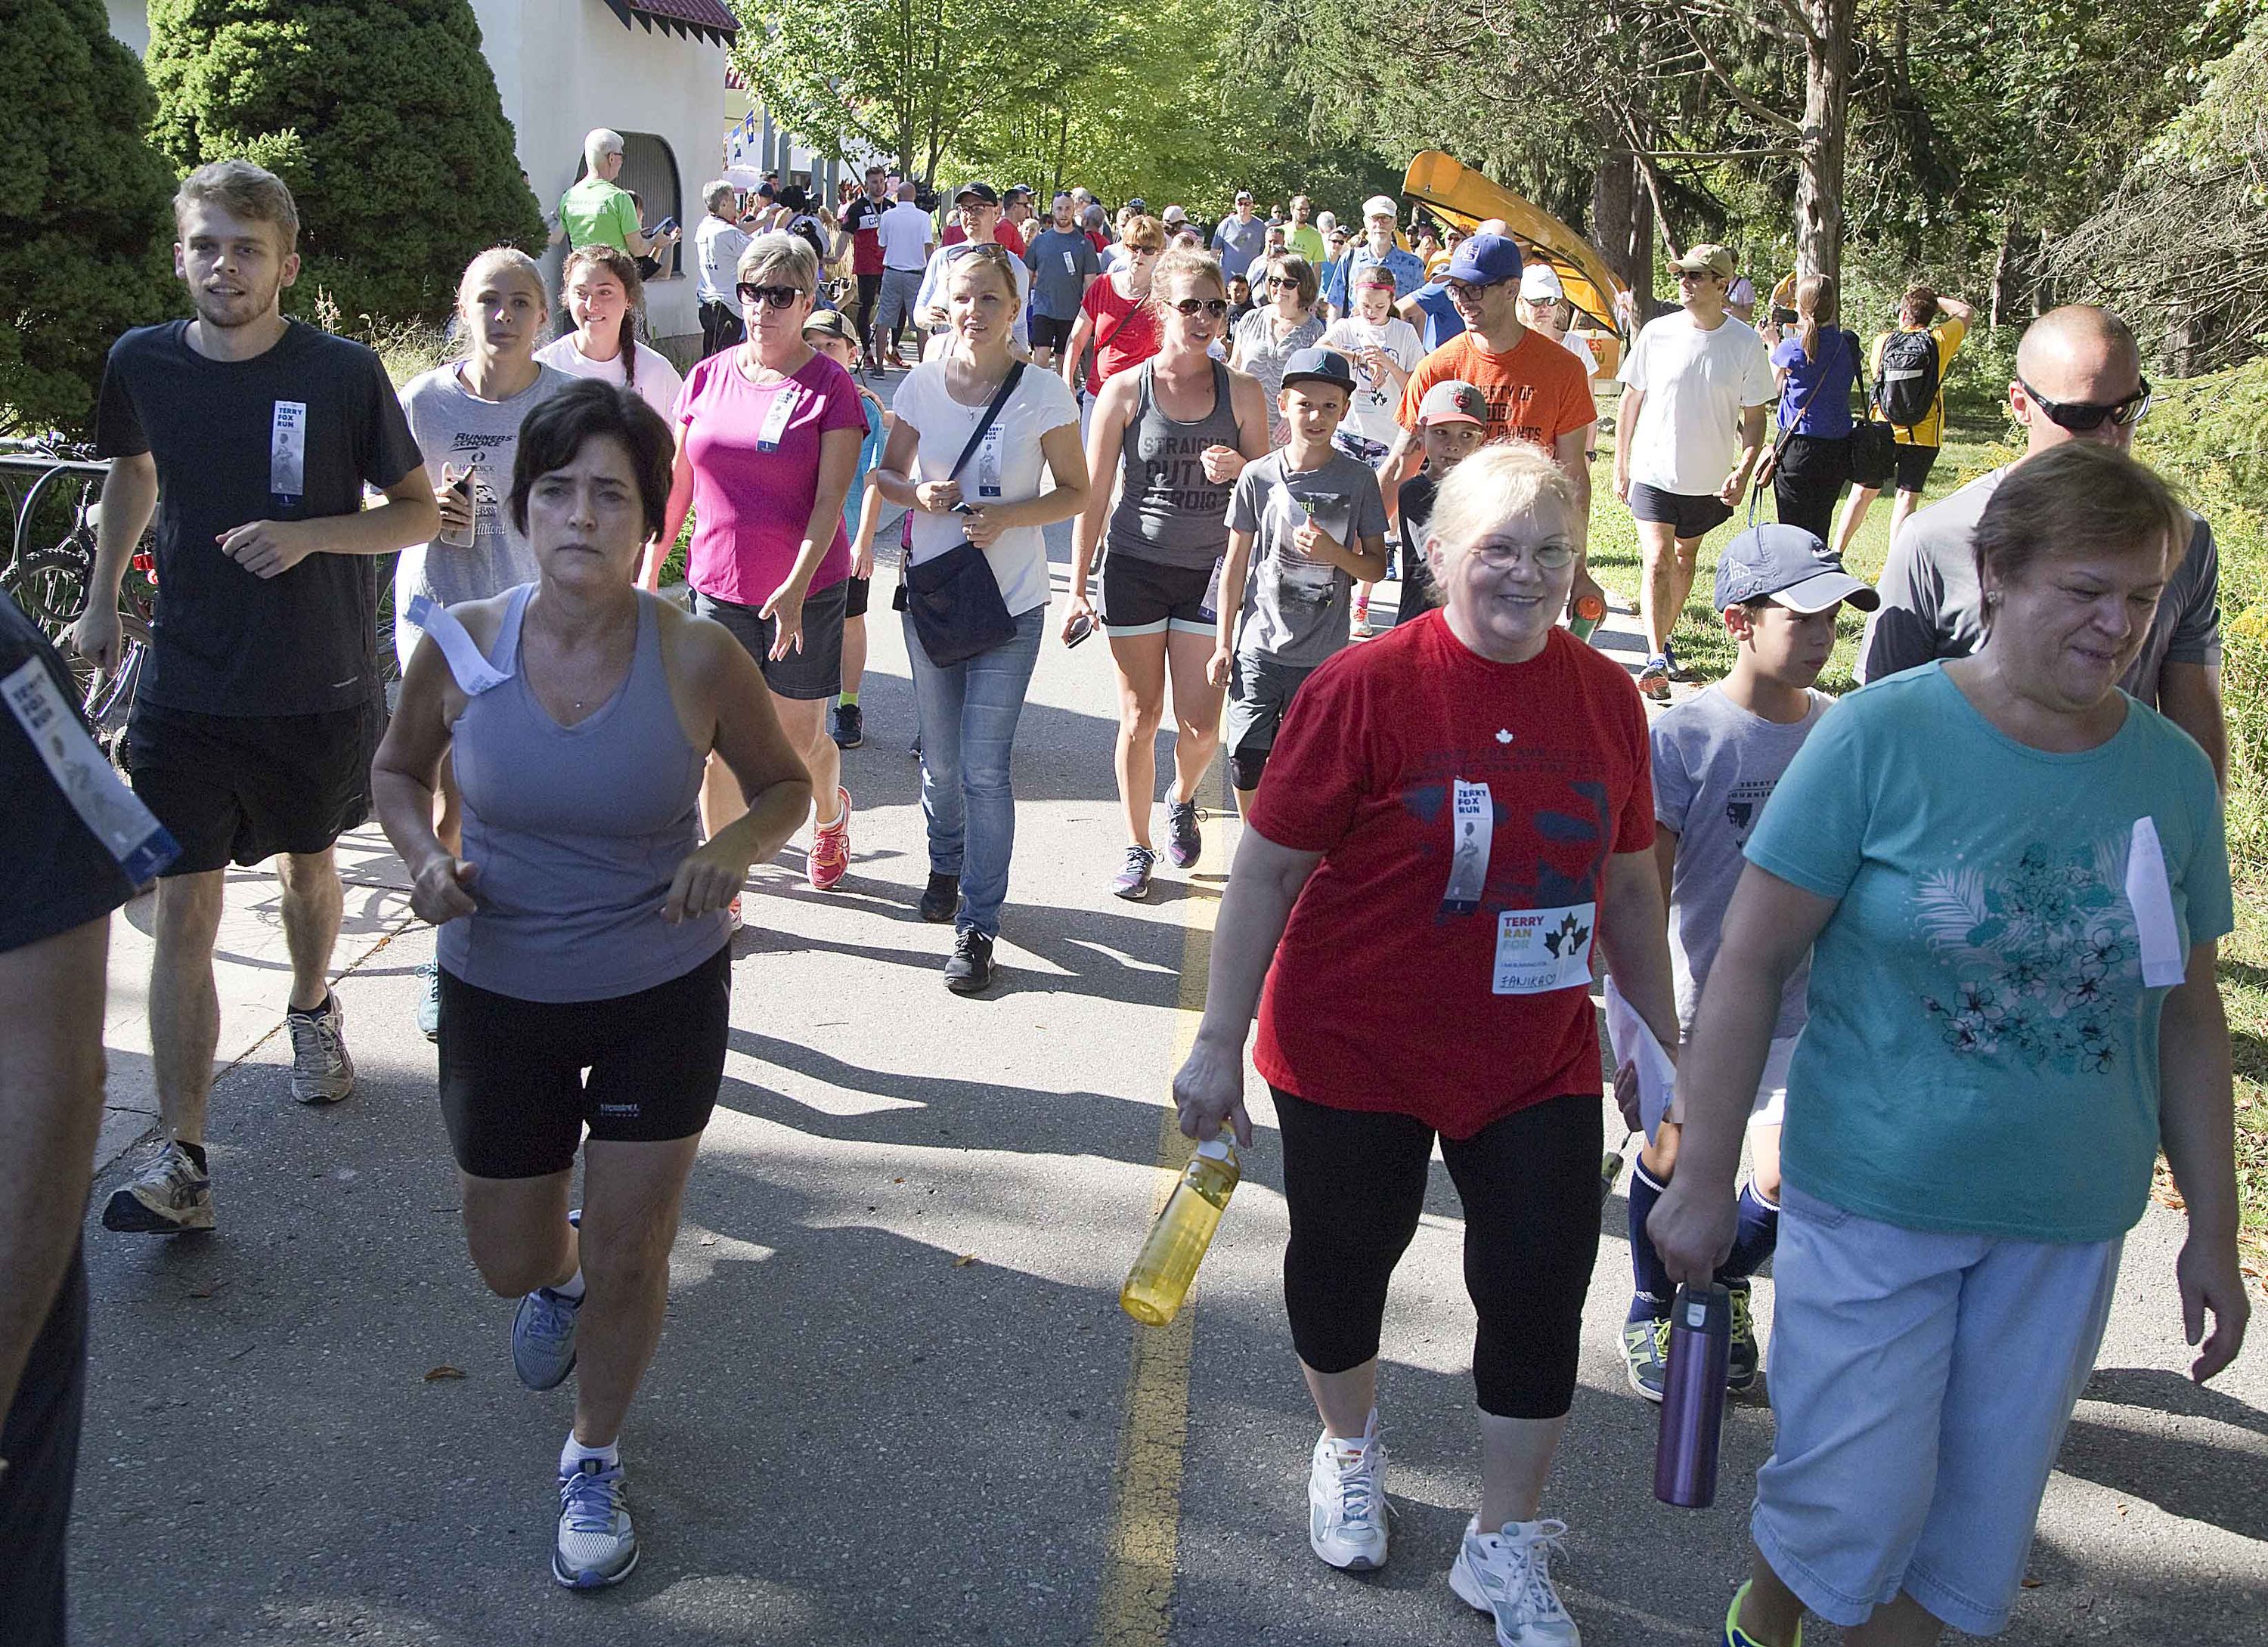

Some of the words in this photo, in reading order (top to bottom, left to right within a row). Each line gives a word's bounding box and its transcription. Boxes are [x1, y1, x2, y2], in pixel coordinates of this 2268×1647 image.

[1519, 386, 1535, 400] OF
[1458, 789, 1487, 797] TERRY
[1458, 806, 1479, 814] RUN
[1504, 915, 1545, 927] TERRY
[1504, 928, 1532, 938] RAN
